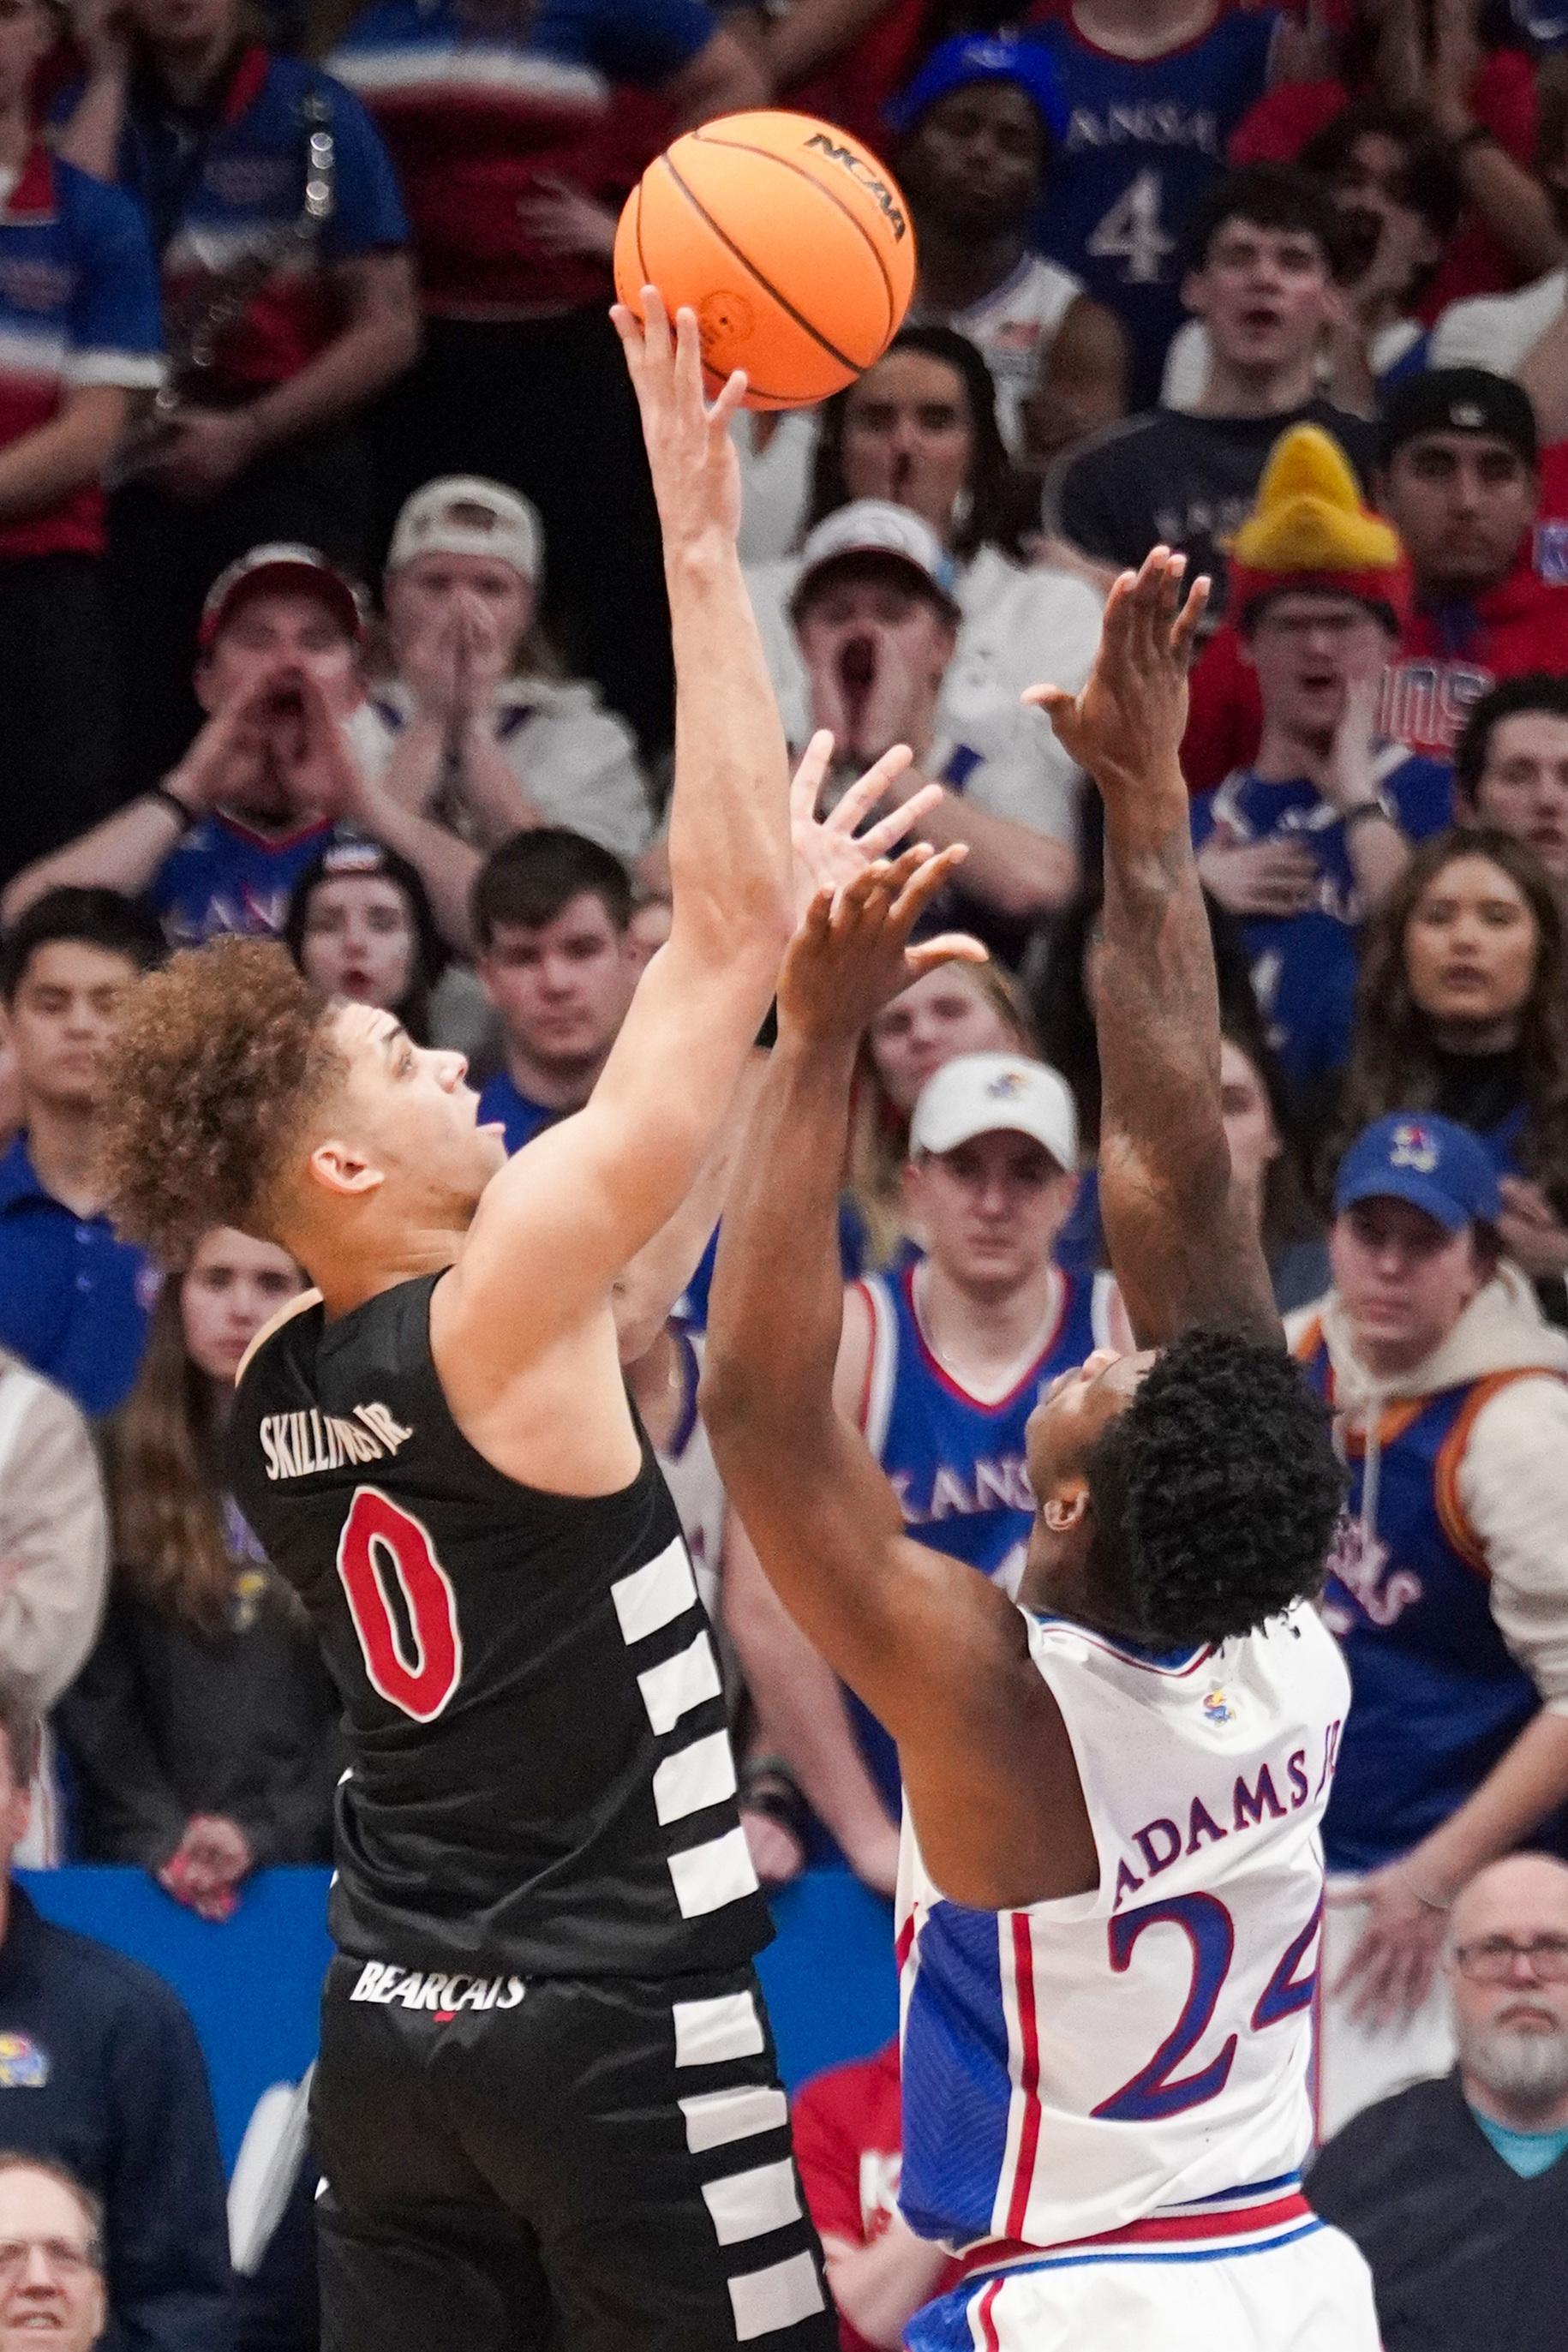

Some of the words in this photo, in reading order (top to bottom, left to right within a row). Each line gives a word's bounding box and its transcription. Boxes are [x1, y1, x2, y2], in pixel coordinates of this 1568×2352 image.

[803, 133, 906, 244] NCAA
[1085, 168, 1176, 284] 4
[260, 1409, 382, 1481] SKILLINGS
[336, 1485, 463, 1723] 0
[1112, 1748, 1310, 1912] ADAMS
[349, 1960, 525, 2012] BEARCATS
